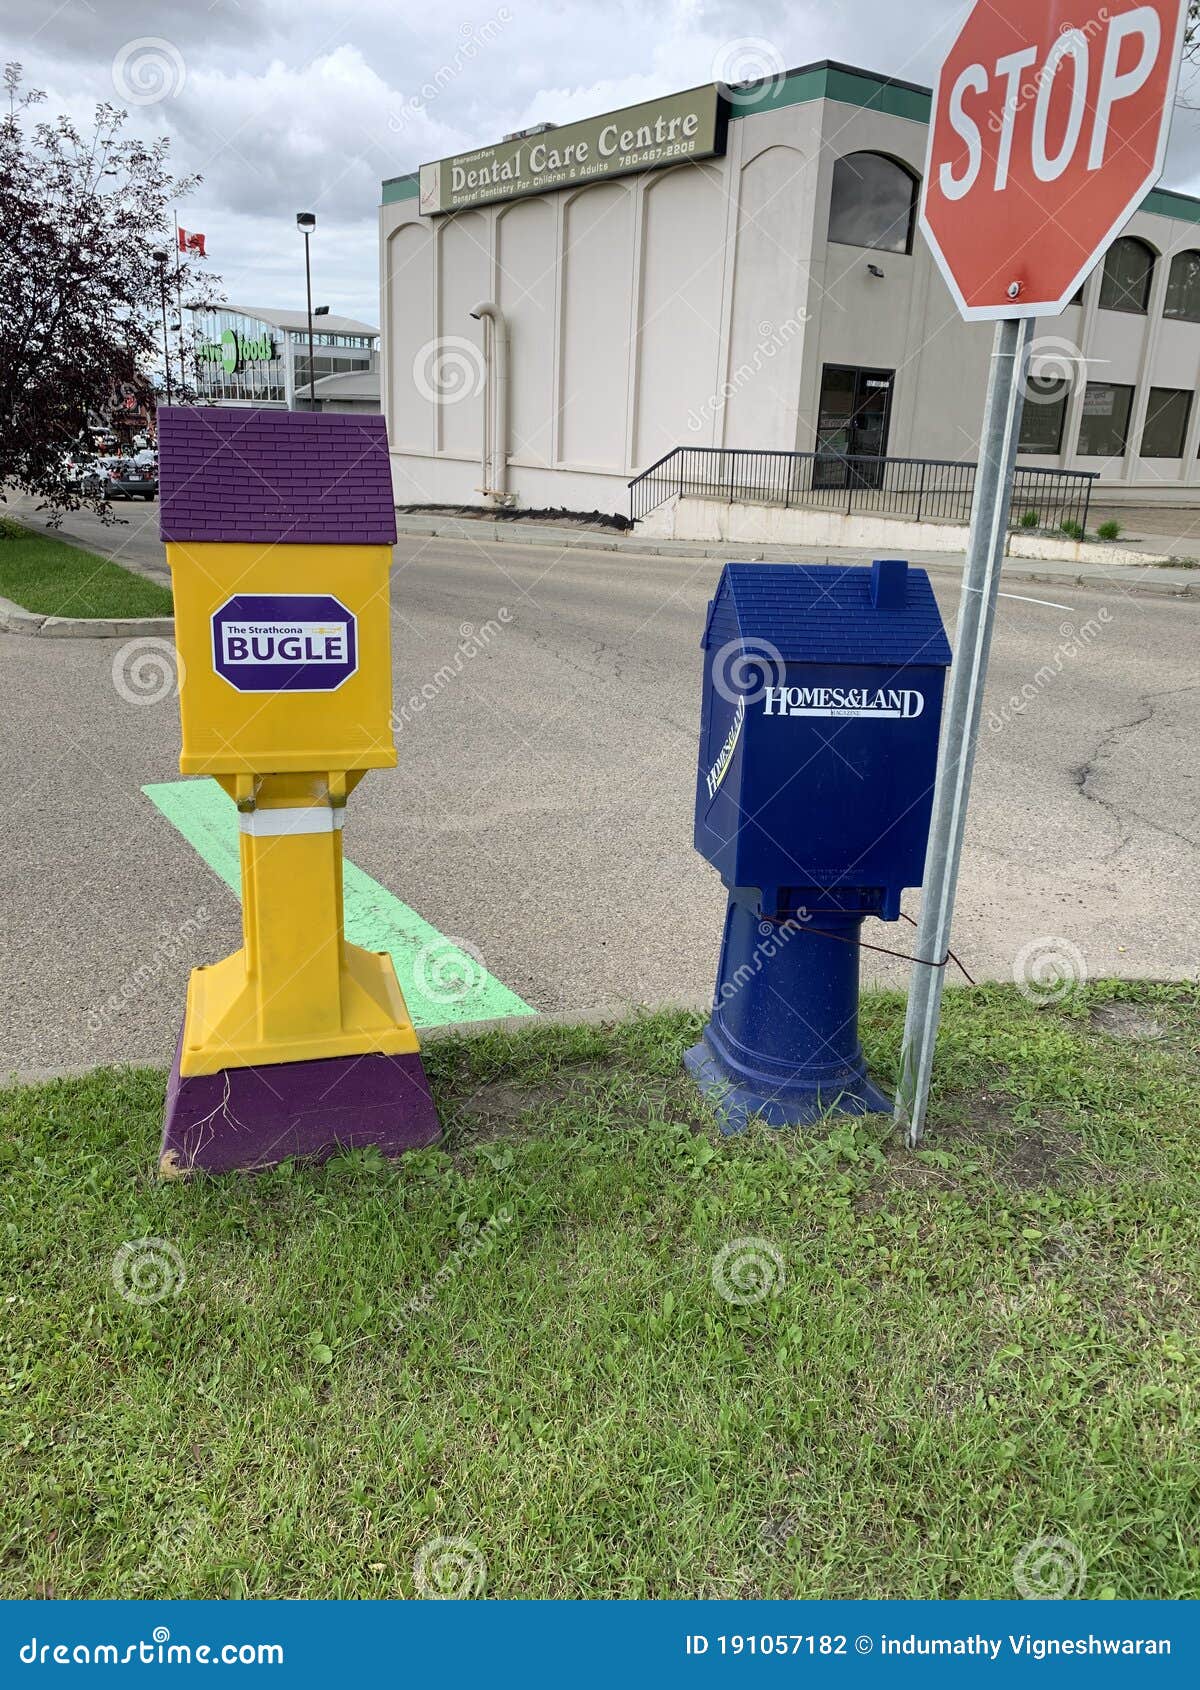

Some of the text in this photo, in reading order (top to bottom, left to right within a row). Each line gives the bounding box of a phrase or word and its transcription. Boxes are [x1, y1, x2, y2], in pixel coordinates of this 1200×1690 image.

[939, 6, 1161, 201] STOP
[452, 113, 699, 193] Dental Care Centre
[453, 191, 478, 204] General
[480, 182, 514, 198] Dentistry
[517, 180, 531, 189] For
[533, 171, 566, 186] Children
[580, 162, 608, 177] Adults
[238, 333, 273, 361] foods
[227, 626, 303, 634] The Strathcona
[227, 637, 343, 661] BUGLE
